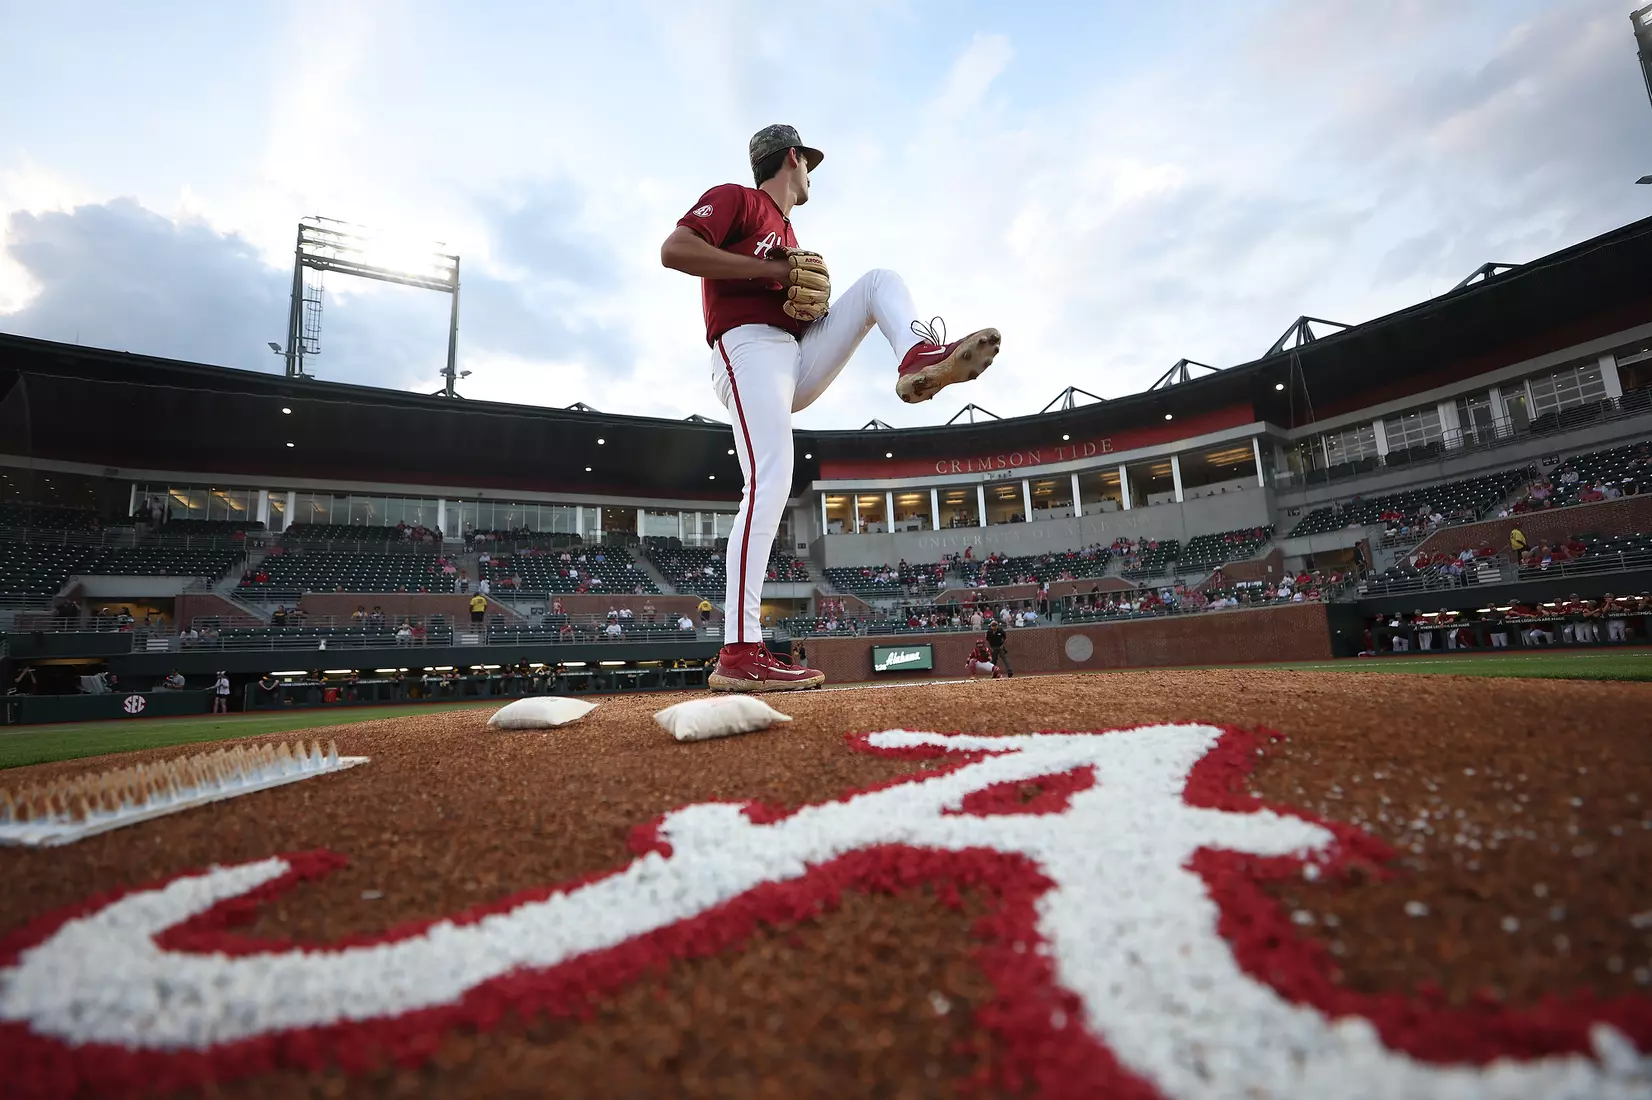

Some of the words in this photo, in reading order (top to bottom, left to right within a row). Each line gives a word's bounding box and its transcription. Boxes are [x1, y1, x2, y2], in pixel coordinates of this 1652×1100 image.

[935, 450, 1041, 475] CRIMSON
[1055, 438, 1114, 461] TIDE
[918, 531, 1021, 549] UNIVERSITY
[124, 695, 146, 713] SEC
